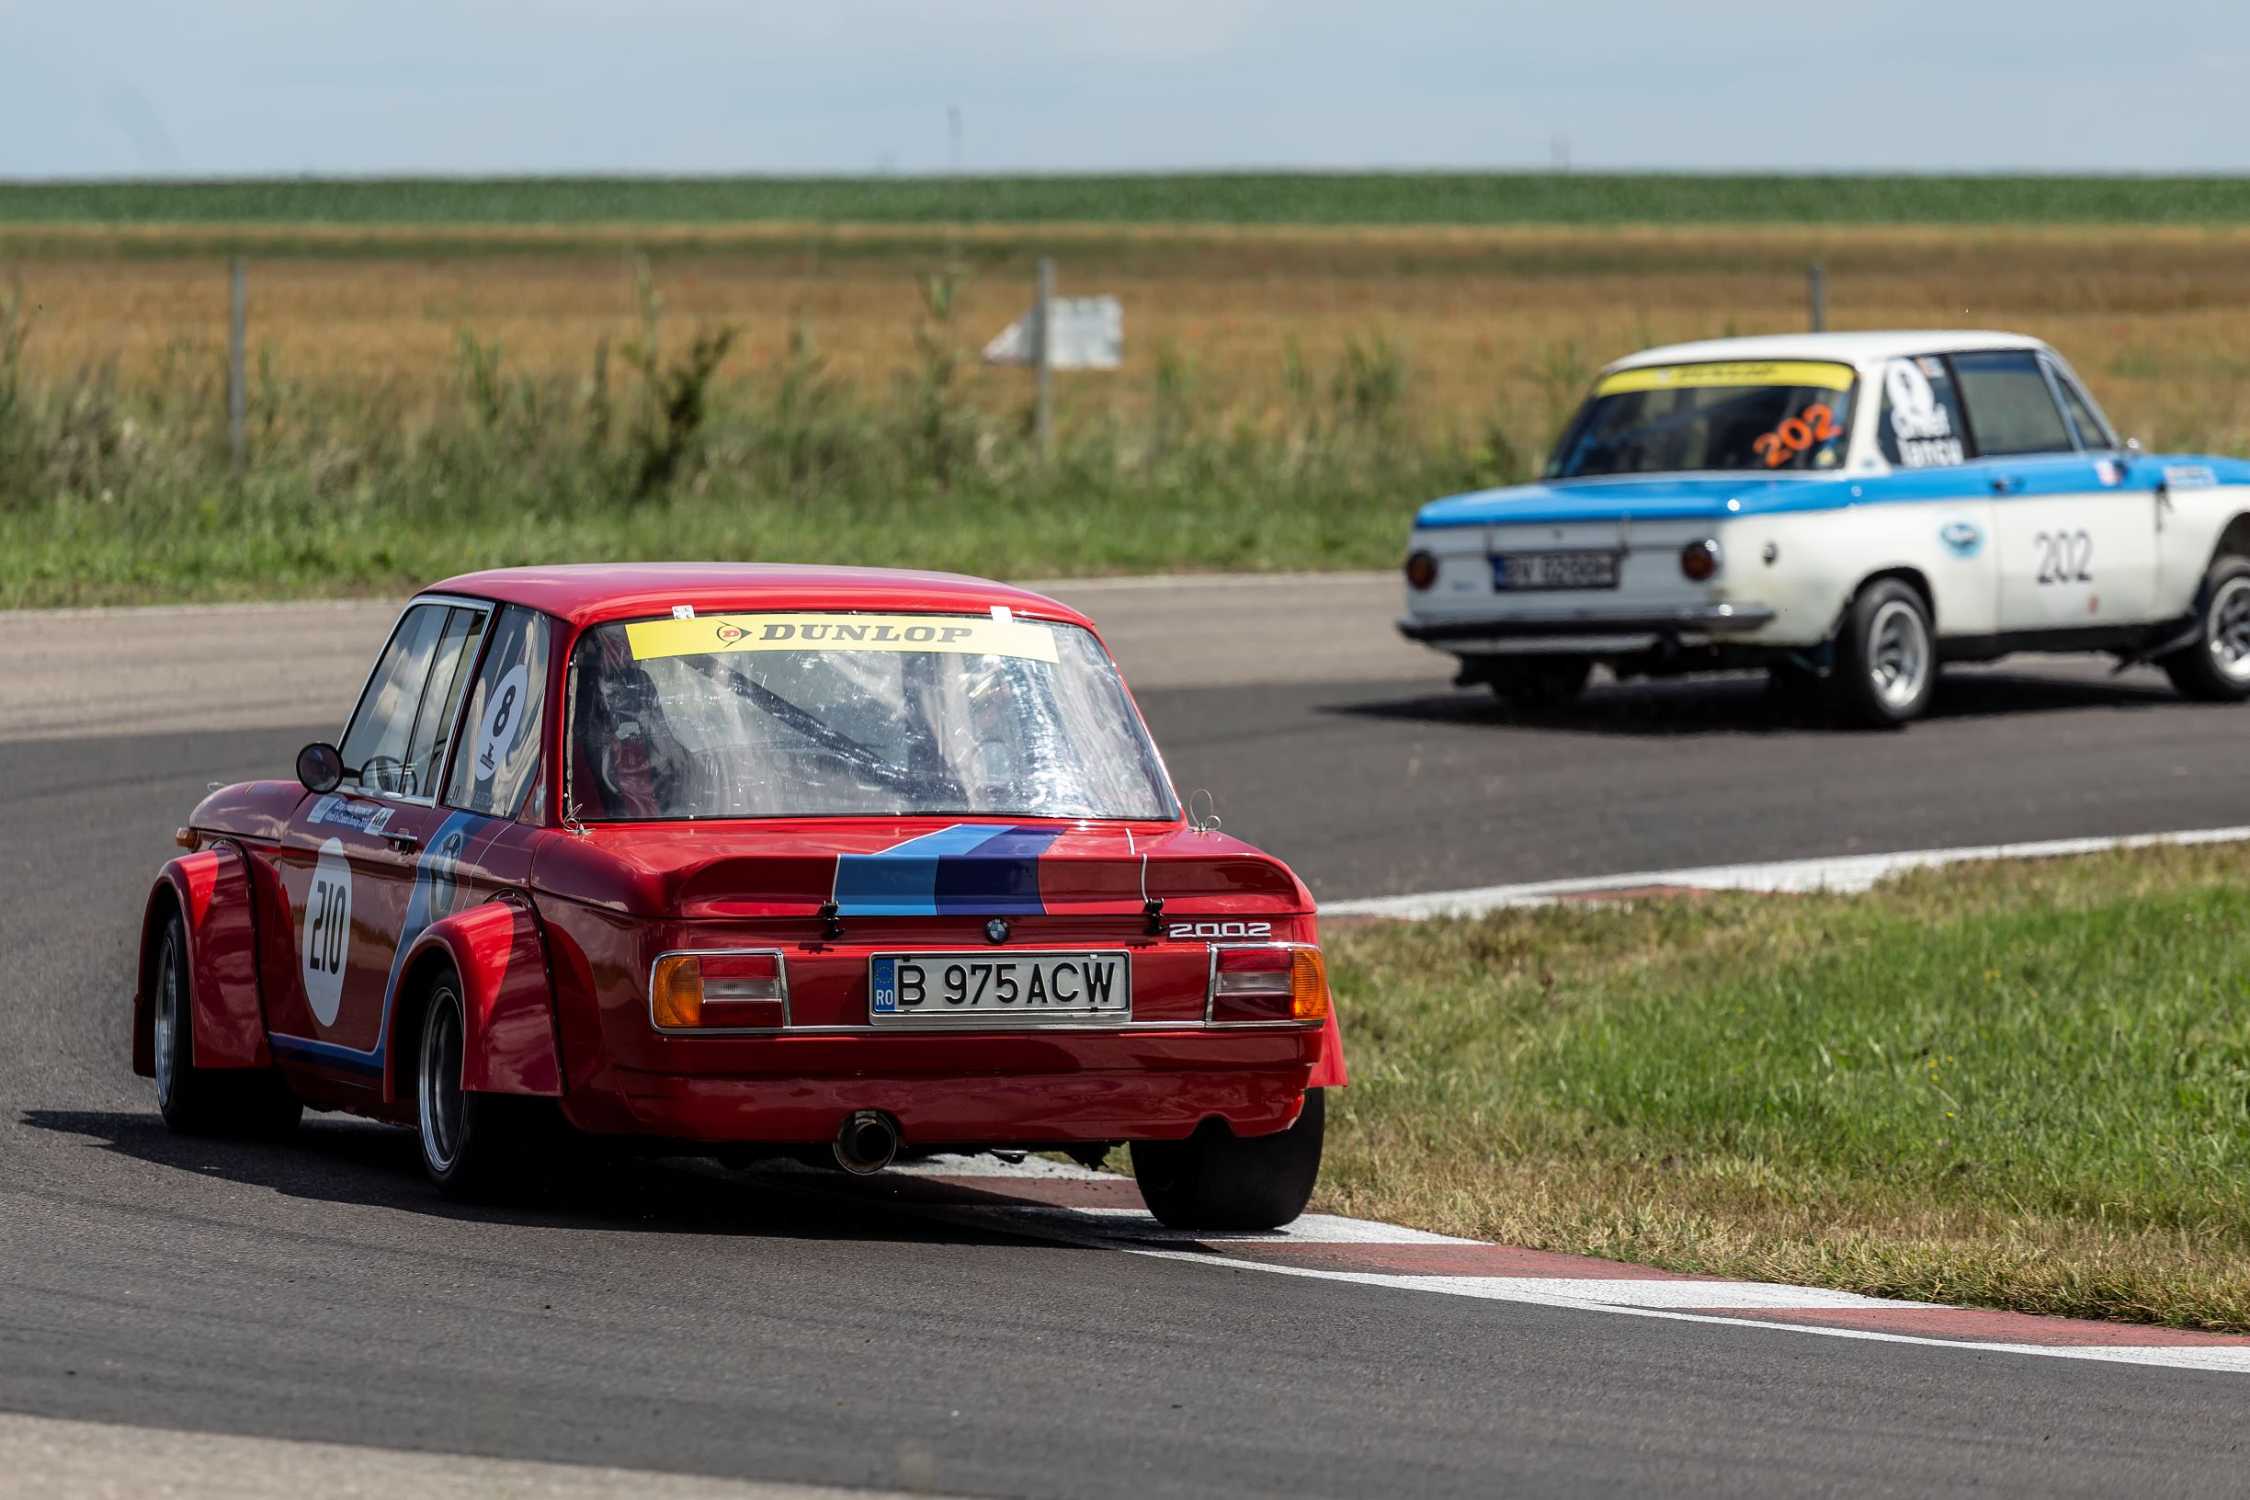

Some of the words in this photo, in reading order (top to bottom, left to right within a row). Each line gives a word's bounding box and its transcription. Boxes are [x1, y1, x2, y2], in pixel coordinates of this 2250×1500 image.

[1753, 403, 1843, 468] 202
[2033, 529, 2094, 586] 202
[759, 624, 973, 643] DUNLOP
[493, 685, 517, 738] 8
[309, 880, 346, 975] 210
[1169, 922, 1272, 938] 2002
[876, 989, 894, 1006] RO
[898, 964, 927, 1006] B
